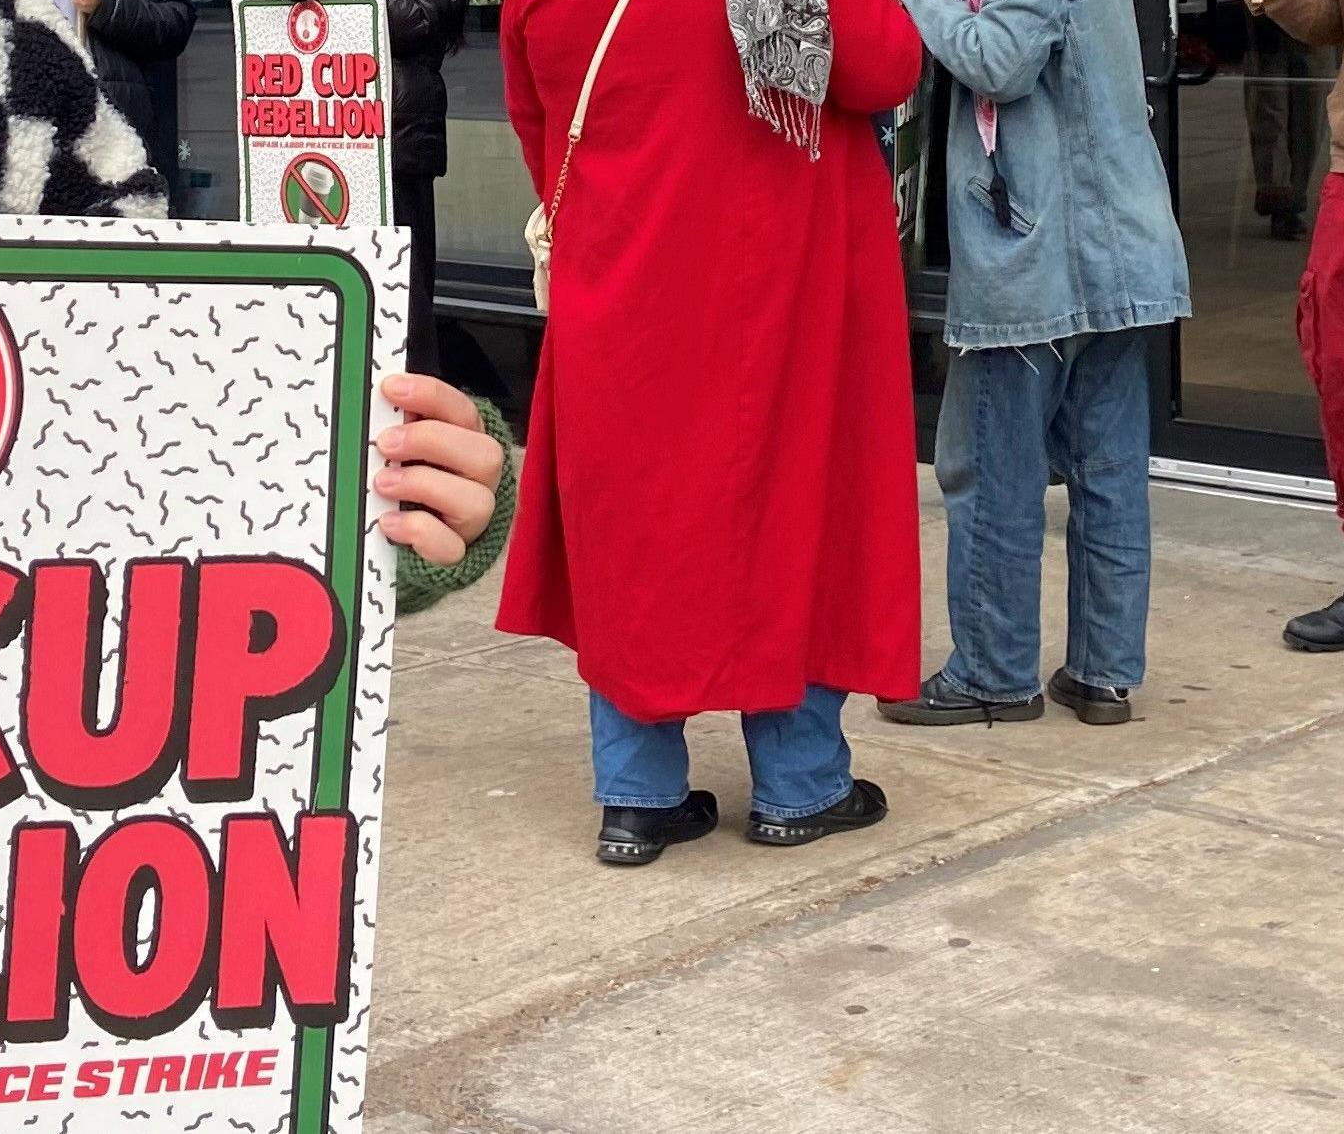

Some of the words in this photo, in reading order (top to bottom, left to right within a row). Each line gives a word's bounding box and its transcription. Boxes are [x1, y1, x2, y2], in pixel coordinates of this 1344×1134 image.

[243, 54, 303, 97] RED
[311, 53, 380, 98] CUP
[241, 99, 385, 138] REBELLION
[73, 1049, 280, 1099] STRIKE
